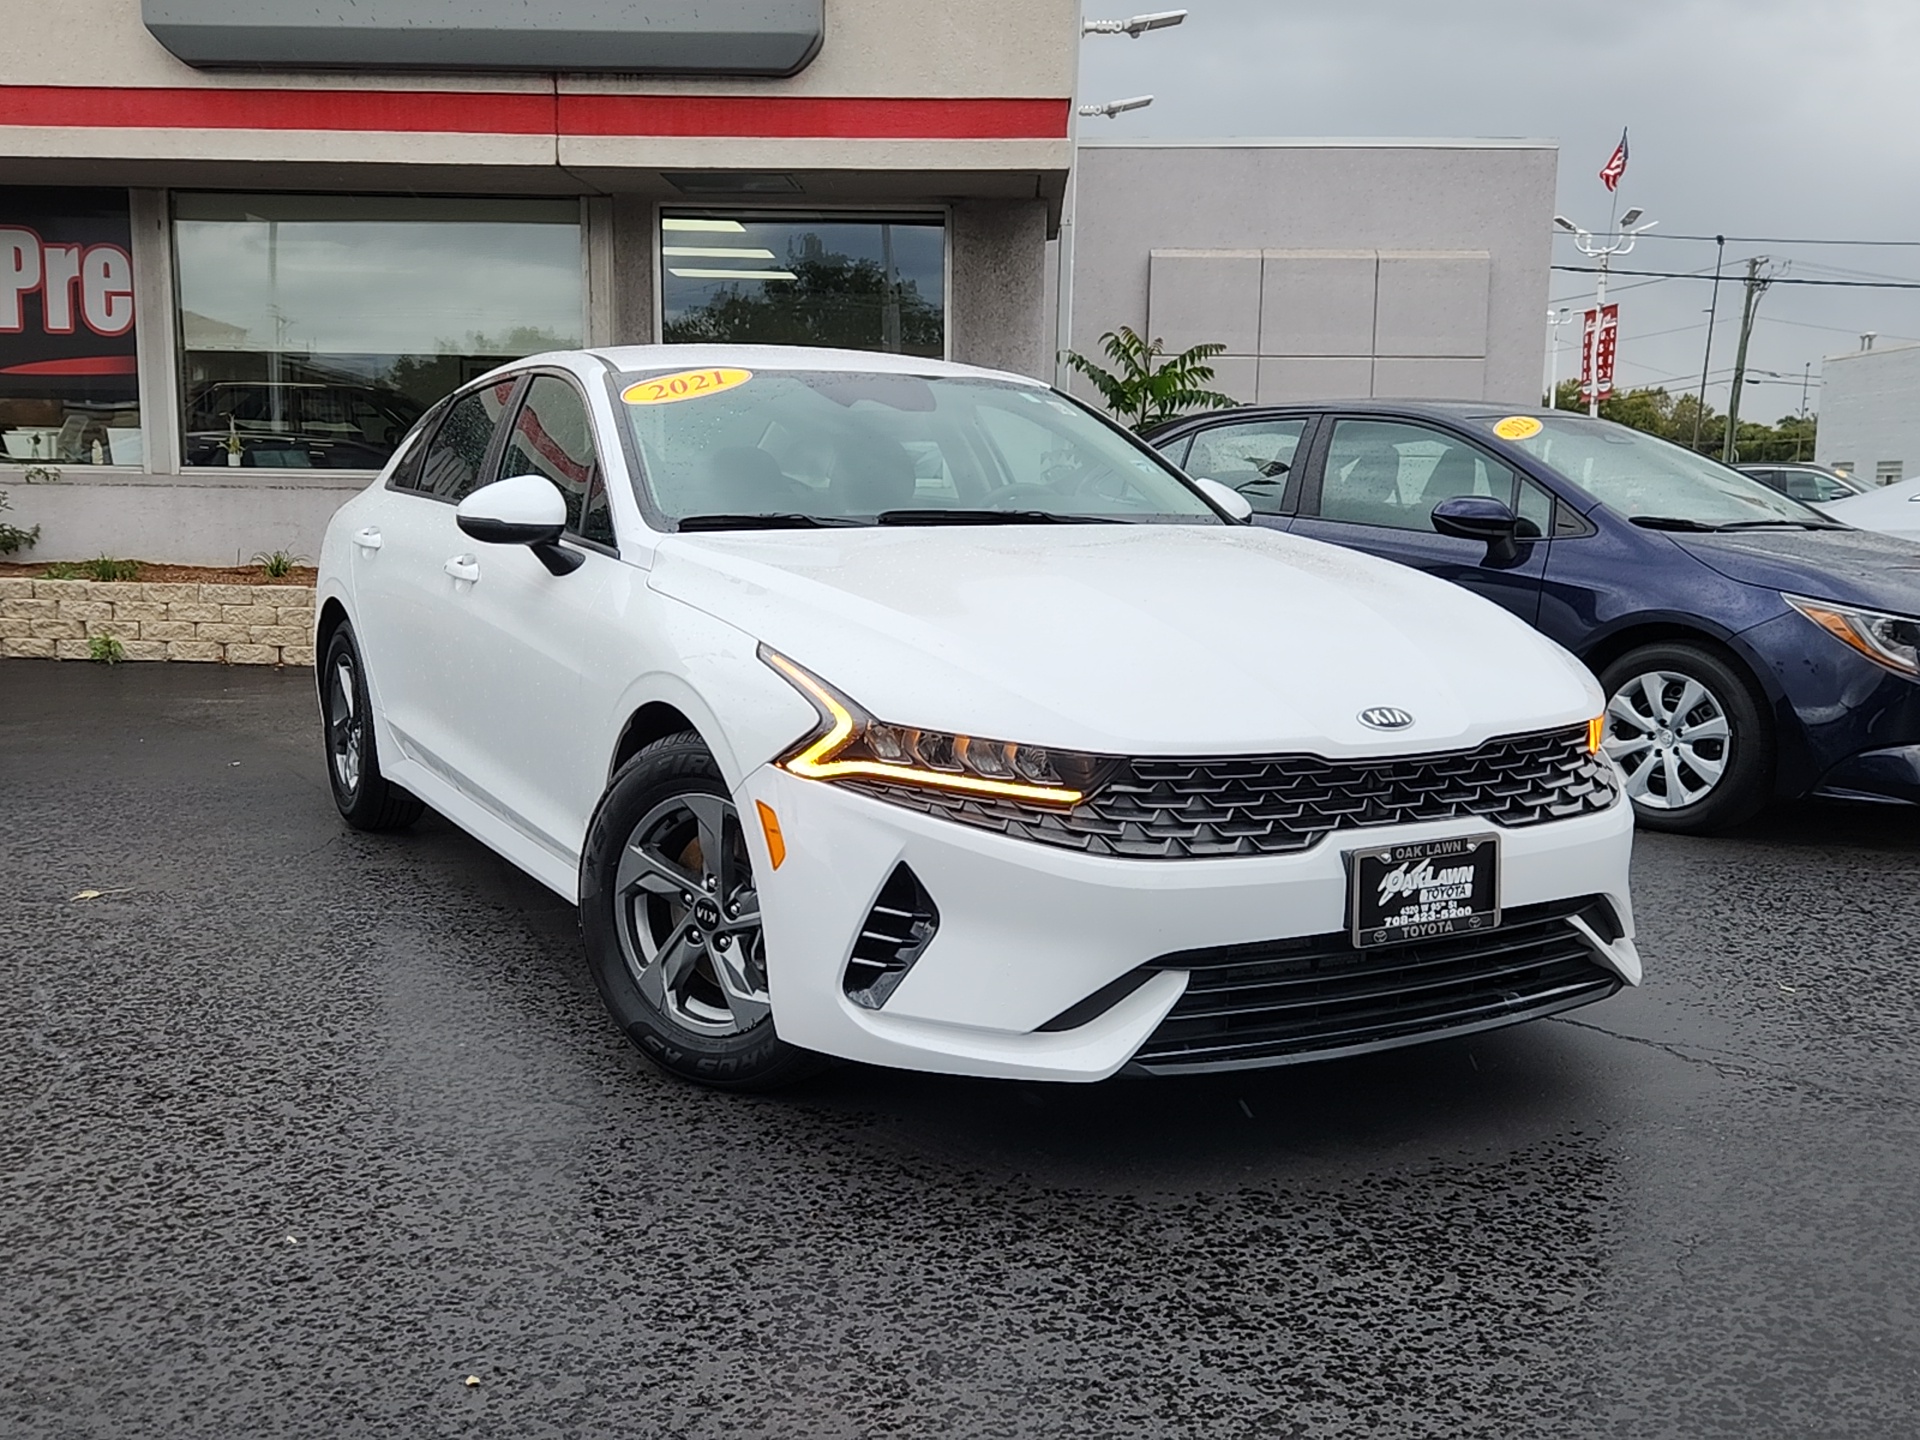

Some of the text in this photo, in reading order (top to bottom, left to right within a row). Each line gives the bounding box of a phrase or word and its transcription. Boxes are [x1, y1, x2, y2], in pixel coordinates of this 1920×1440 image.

[0, 225, 134, 335] Pre
[647, 370, 725, 401] 2021
[1365, 708, 1411, 724] KIA
[1395, 840, 1462, 859] OAK LAWN
[1426, 885, 1467, 901] TOYOTA
[696, 906, 717, 924] KIA
[1420, 903, 1430, 912] W
[1401, 920, 1454, 939] TOYOTA
